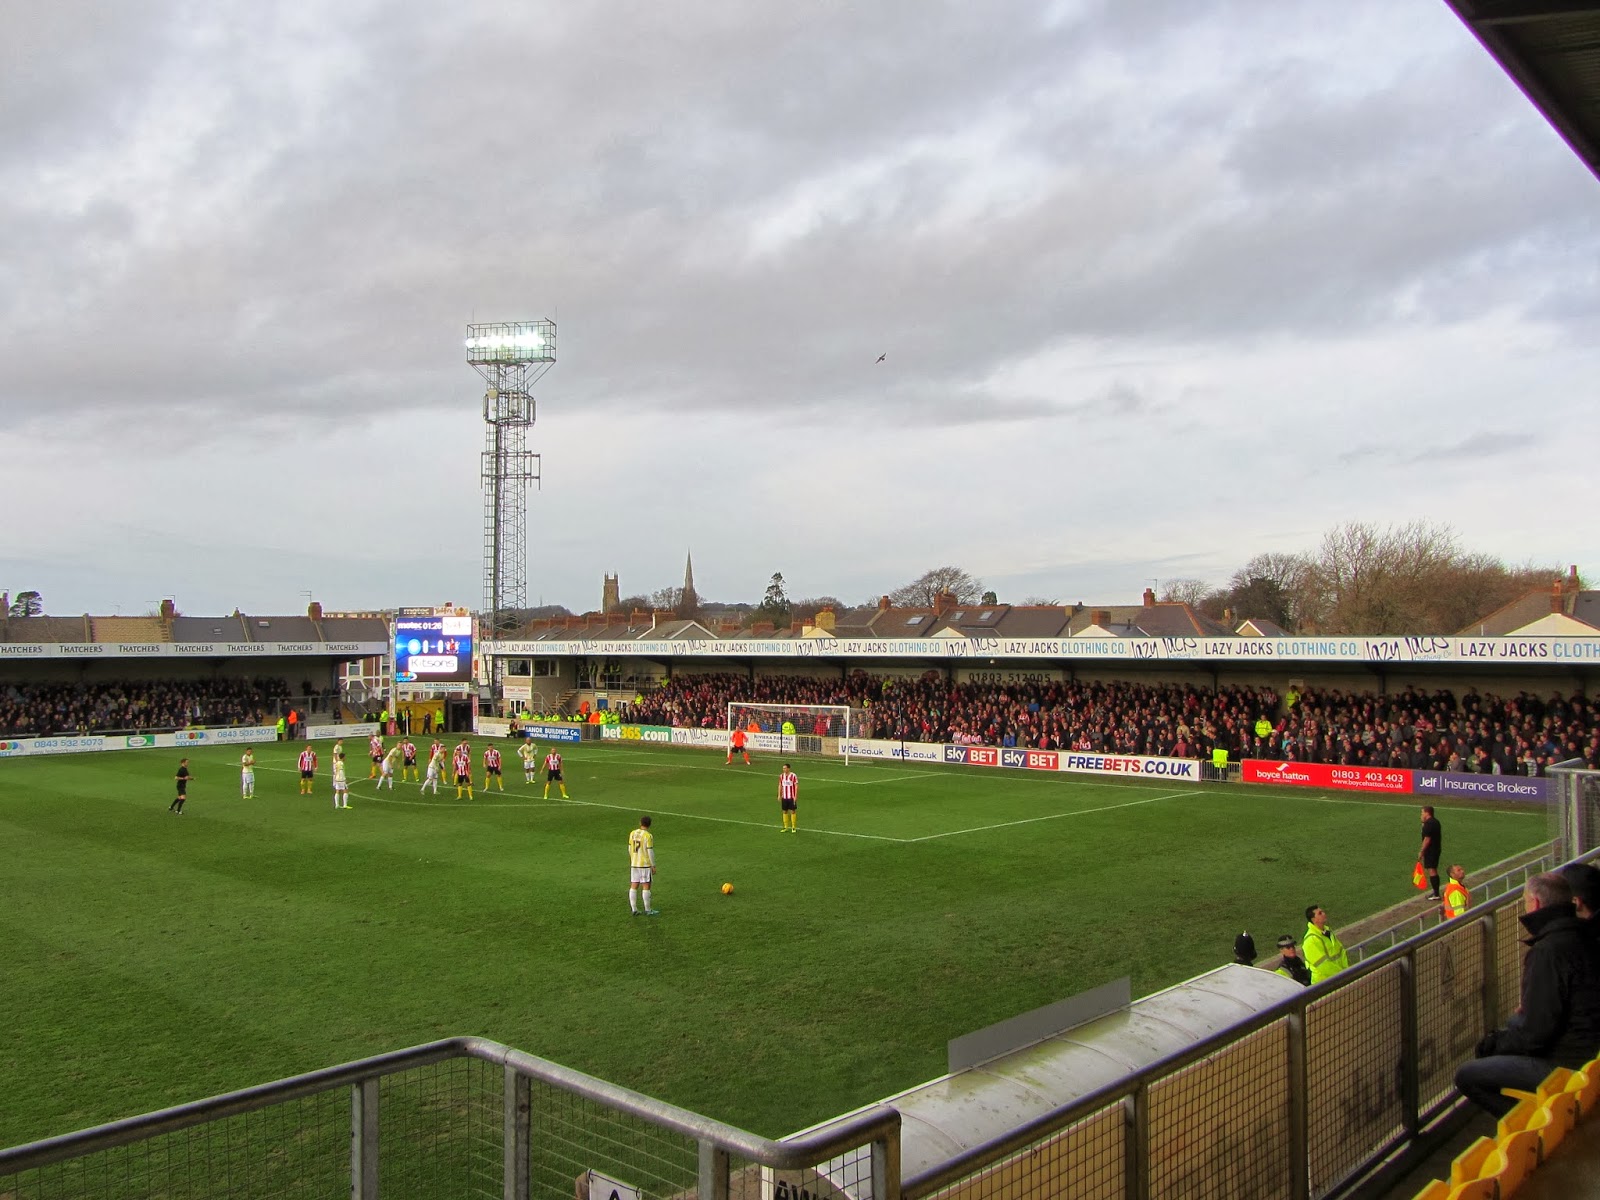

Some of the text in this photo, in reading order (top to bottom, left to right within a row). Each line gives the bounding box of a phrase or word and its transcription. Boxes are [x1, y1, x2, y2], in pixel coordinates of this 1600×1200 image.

[711, 643, 725, 652] LAZY
[727, 643, 747, 652] JACKS
[749, 643, 780, 652] CLOTHING
[843, 643, 861, 652] LAZY
[863, 643, 887, 652] JACKS
[889, 643, 927, 653] CLOTHING
[1004, 643, 1026, 653] LAZY
[1029, 643, 1058, 653] JACKS
[1061, 643, 1107, 654] CLOTHING
[1205, 643, 1232, 655] LAZY
[1236, 643, 1272, 655] JACKS
[1277, 643, 1336, 655] CLOTHING
[1460, 643, 1496, 657] LAZY
[1500, 643, 1547, 657] JACKS
[969, 672, 1002, 681] 01803
[603, 725, 668, 741] bet365.com
[947, 747, 995, 762] sky BET
[1004, 750, 1056, 767] sky BET
[1068, 756, 1192, 776] FREEBETS.CO.UK
[1256, 770, 1404, 782] boyce hatton 01803 403 403
[1332, 778, 1403, 789] www.boycehatton.co.uk
[1420, 777, 1537, 795] Jelf Insurance Brokers
